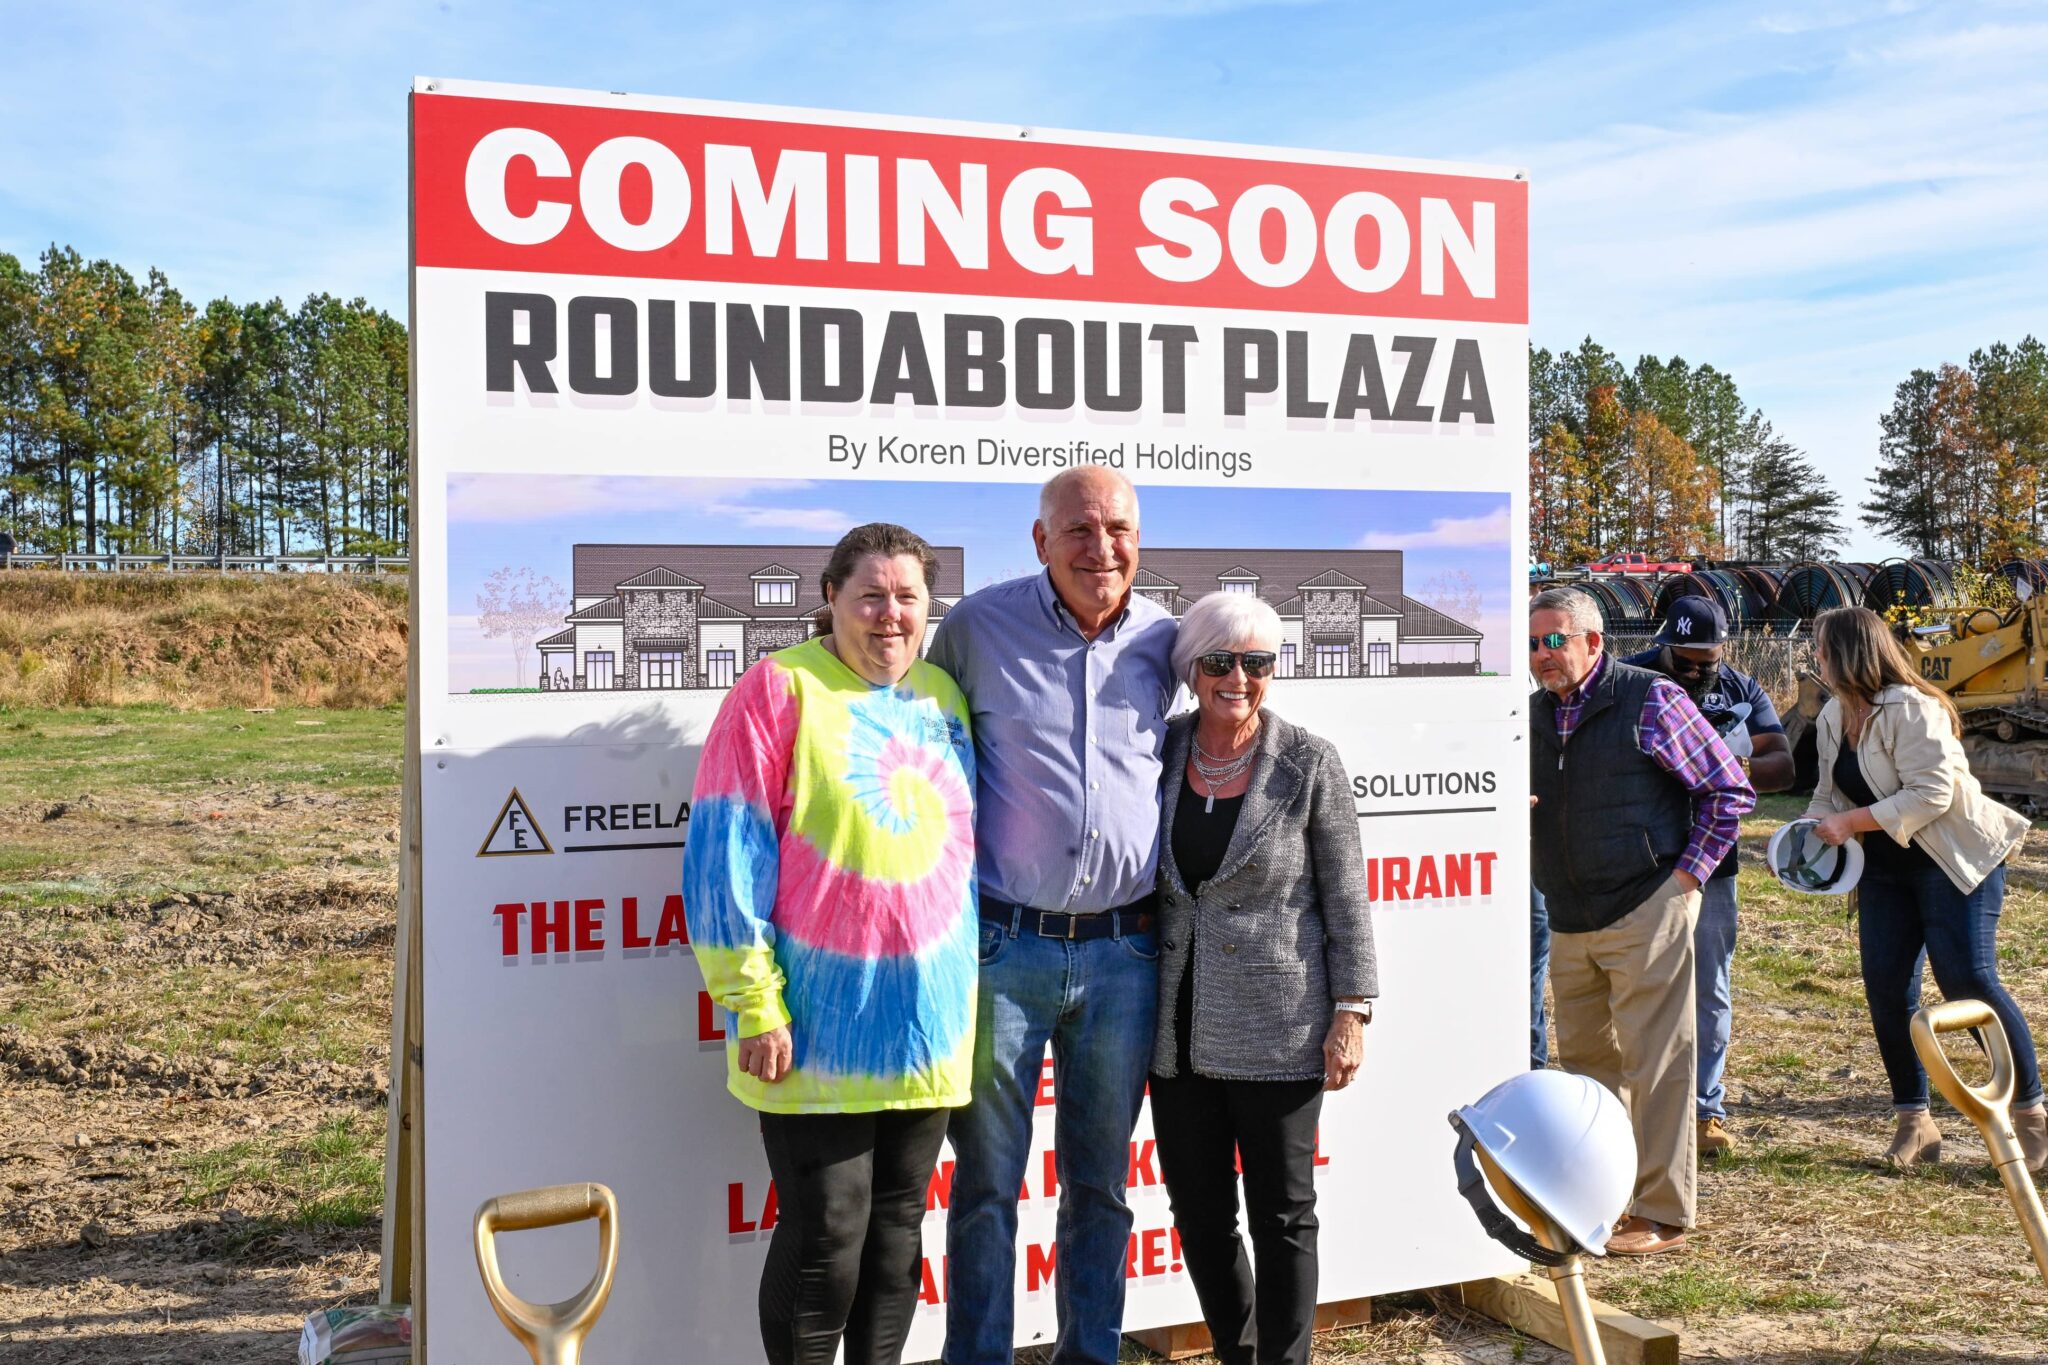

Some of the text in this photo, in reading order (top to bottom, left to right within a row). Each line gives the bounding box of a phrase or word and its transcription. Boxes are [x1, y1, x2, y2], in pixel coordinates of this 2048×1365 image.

[465, 127, 1496, 299] COMING SOON
[485, 291, 1495, 424] ROUNDABOUT PLAZA
[828, 434, 1252, 478] By Koren Diversified Holdings
[1677, 616, 1692, 635] NY
[1921, 656, 1952, 681] CAT
[564, 771, 1497, 832] FREELA SOLUTIONS
[493, 899, 606, 956] THE
[622, 895, 690, 949] LA
[1027, 1227, 1183, 1292] MRE!
